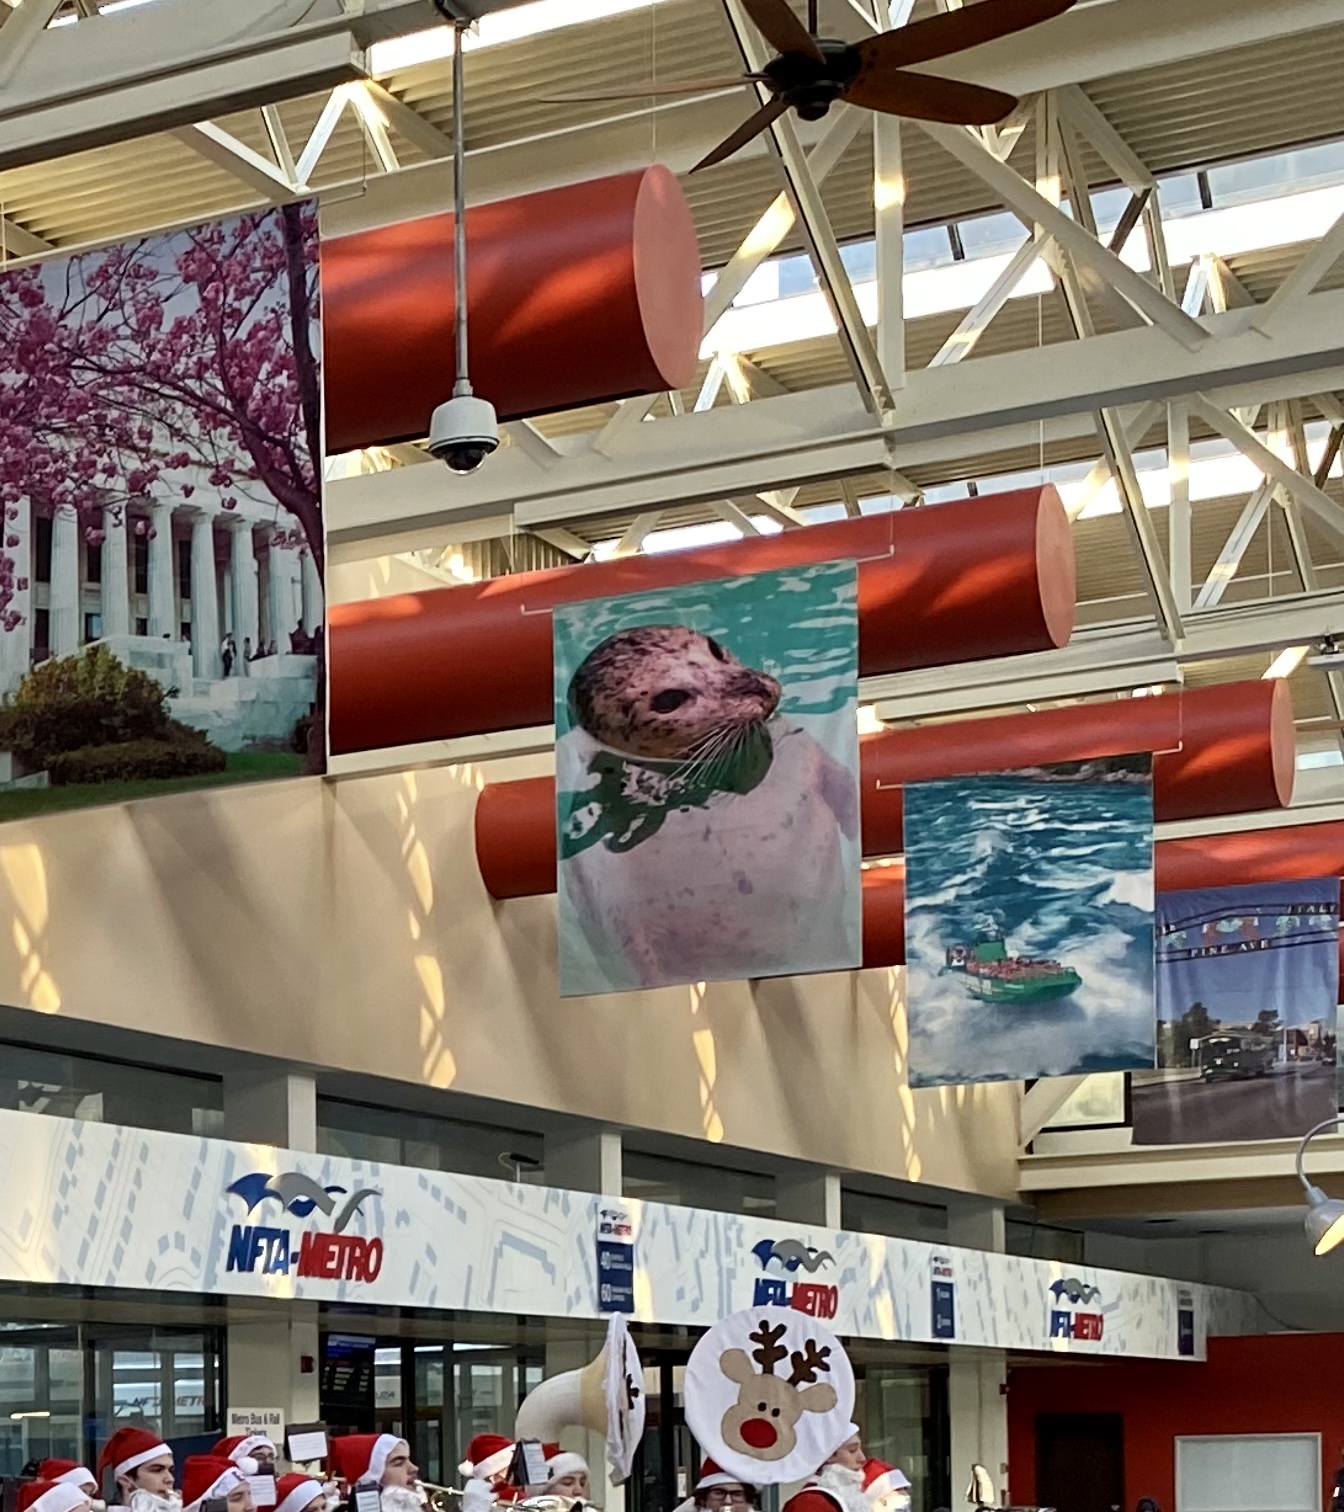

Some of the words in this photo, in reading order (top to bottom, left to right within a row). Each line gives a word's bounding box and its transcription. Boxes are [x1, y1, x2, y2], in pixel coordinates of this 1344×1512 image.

[1191, 944, 1229, 957] PINE
[1239, 939, 1269, 951] AVE
[226, 1224, 384, 1284] NFTA-METRO
[251, 1413, 262, 1424] Bus
